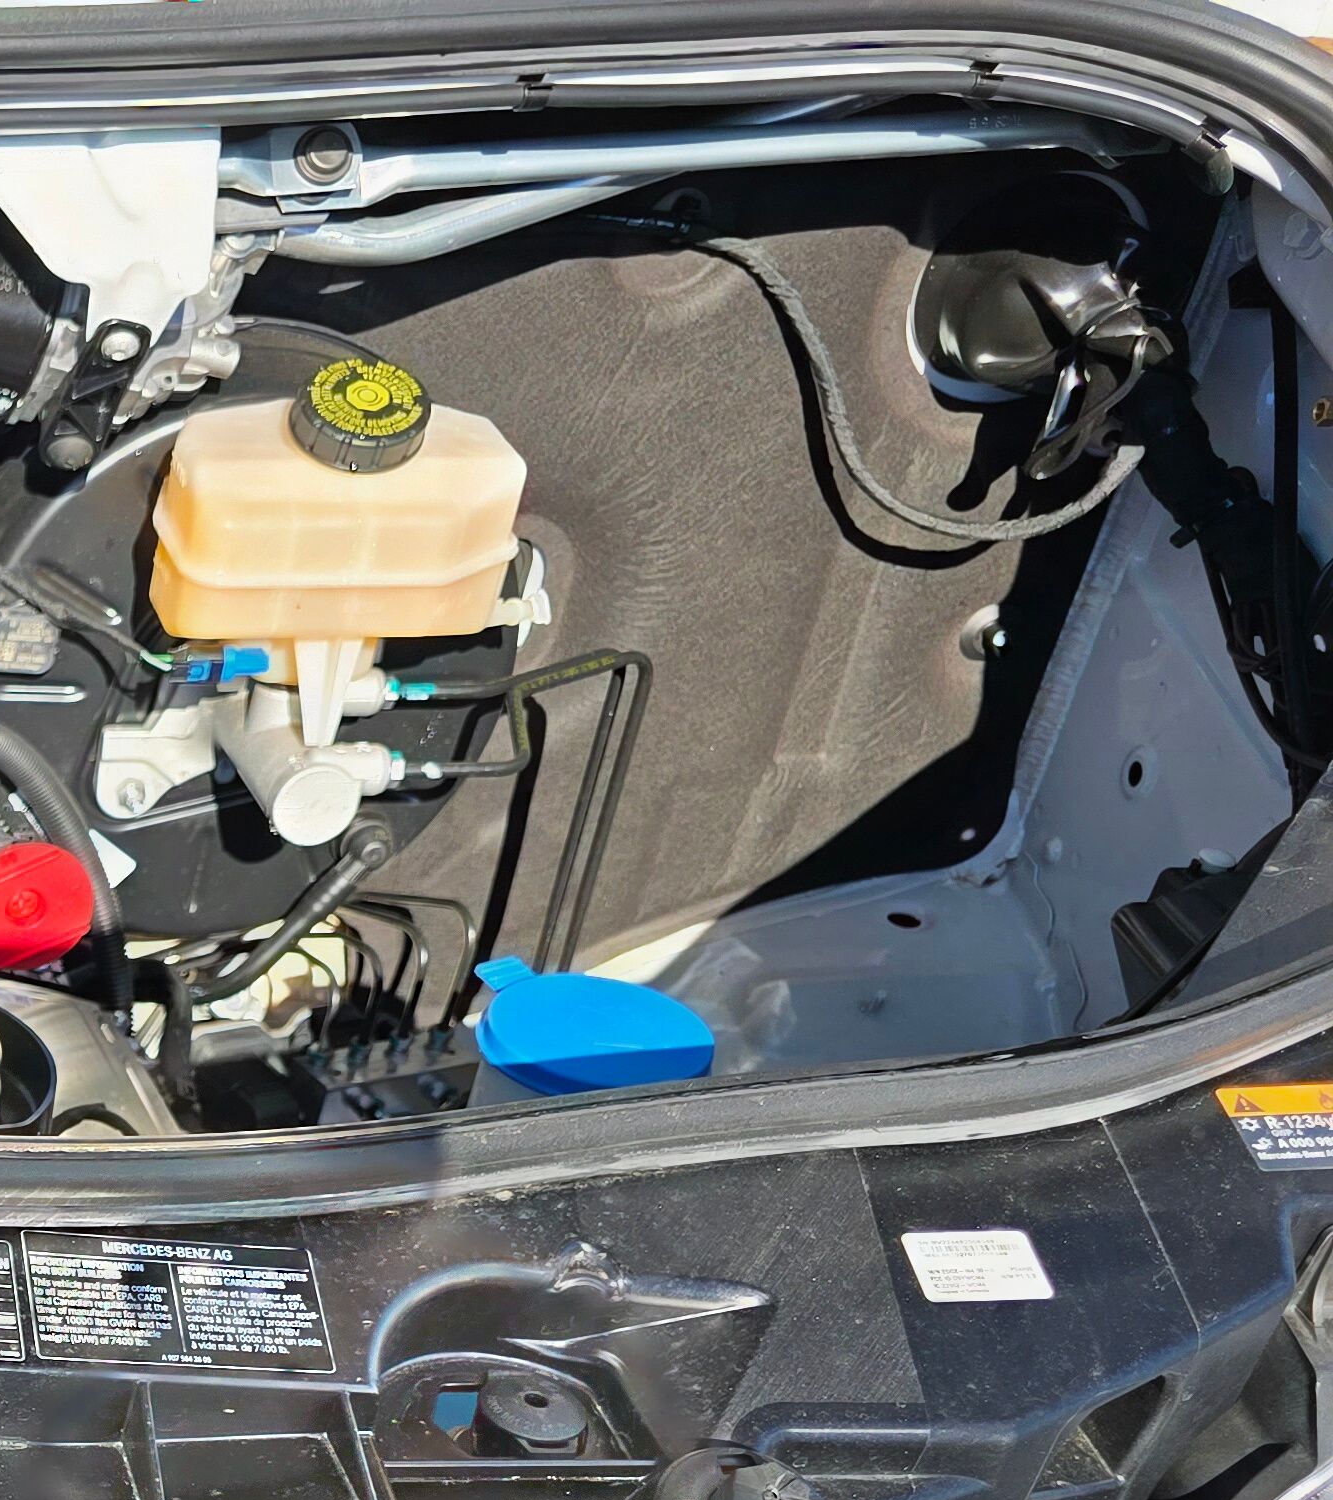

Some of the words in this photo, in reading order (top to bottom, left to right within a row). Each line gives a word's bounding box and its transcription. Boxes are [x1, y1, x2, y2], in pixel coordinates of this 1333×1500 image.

[100, 1240, 213, 1260] MERCEDES-BENZ
[212, 1248, 234, 1262] AG
[81, 1259, 144, 1272] INFORMATION
[176, 1265, 244, 1278] INFORMATIONS
[244, 1269, 308, 1282] IMPORTANTES
[177, 1274, 205, 1284] POUR
[31, 1276, 51, 1287] This
[51, 1278, 83, 1288] vehicle
[82, 1279, 101, 1289] and
[100, 1280, 130, 1292] engine
[130, 1282, 167, 1293] conform
[55, 1288, 101, 1300] applicable
[136, 1293, 163, 1303] CARB
[192, 1287, 229, 1297] véhicule
[249, 1291, 281, 1300] moteur
[281, 1293, 302, 1302] sont
[34, 1296, 52, 1305] and
[52, 1297, 93, 1307] Canadian
[93, 1299, 142, 1311] regulations
[152, 1303, 169, 1312] the
[181, 1296, 228, 1306] conformes
[227, 1298, 245, 1307] aux
[245, 1299, 287, 1309] directives
[287, 1302, 307, 1310] EPA
[35, 1305, 56, 1314] time
[67, 1307, 122, 1318] manufacture
[136, 1311, 172, 1321] vehicles
[183, 1304, 209, 1314] CARB
[260, 1309, 294, 1318] Canada
[294, 1311, 320, 1321] appli-
[36, 1314, 63, 1324] under
[64, 1315, 94, 1326] 10000
[108, 1318, 137, 1328] GVWR
[137, 1319, 154, 1329] and
[154, 1320, 172, 1330] has
[184, 1314, 214, 1323] cables
[231, 1316, 252, 1325] date
[265, 1318, 313, 1330] production
[199, 1323, 236, 1333] véhicule
[236, 1325, 262, 1336] ayant
[274, 1327, 301, 1336] PNBV
[45, 1324, 89, 1334] maximum
[129, 1328, 162, 1338] vehicle
[38, 1332, 70, 1344] weight
[109, 1336, 134, 1346] 7400
[234, 1334, 263, 1343] 10000
[296, 1337, 323, 1348] poids
[197, 1341, 216, 1350] vide
[217, 1342, 239, 1351] max.
[252, 1344, 278, 1353] 7400
